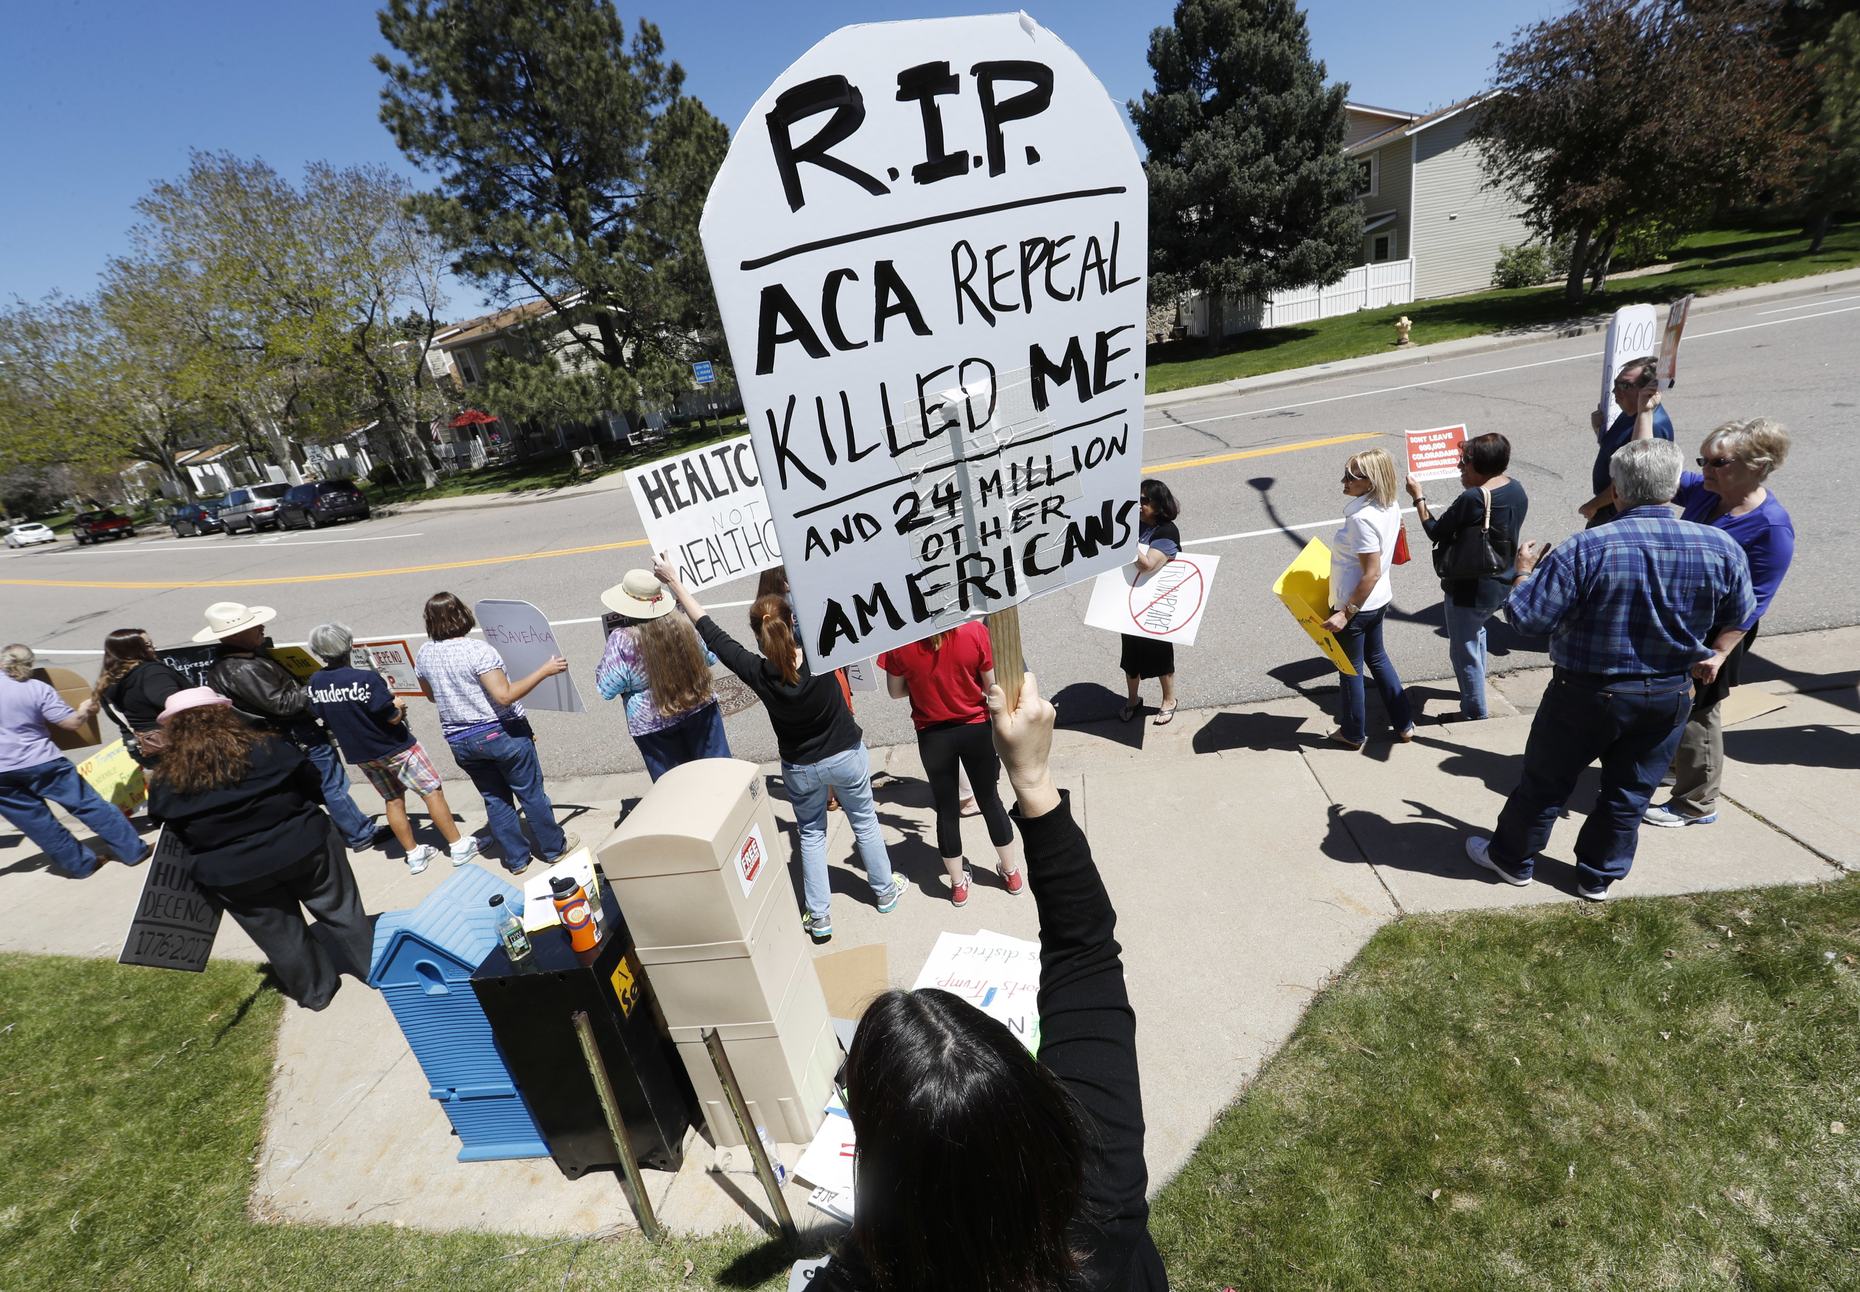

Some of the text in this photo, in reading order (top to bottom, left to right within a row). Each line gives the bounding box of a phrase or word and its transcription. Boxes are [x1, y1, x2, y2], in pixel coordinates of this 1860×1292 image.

[766, 61, 1053, 213] R.I.P.
[756, 222, 1140, 375] ACA REPEAL
[766, 324, 1139, 490] KILLED ME.
[1429, 432, 1453, 441] LEAVE
[637, 440, 763, 519] HEALTC
[804, 424, 1128, 562] AND 24 MILLION
[711, 500, 759, 530] NOT
[921, 495, 1071, 562] OTHER
[818, 500, 1139, 658] AMERICANS
[1144, 564, 1187, 632] TRUMPCARE
[741, 839, 759, 873] FREE
[141, 890, 219, 929] DECENCY
[951, 945, 1019, 964] district
